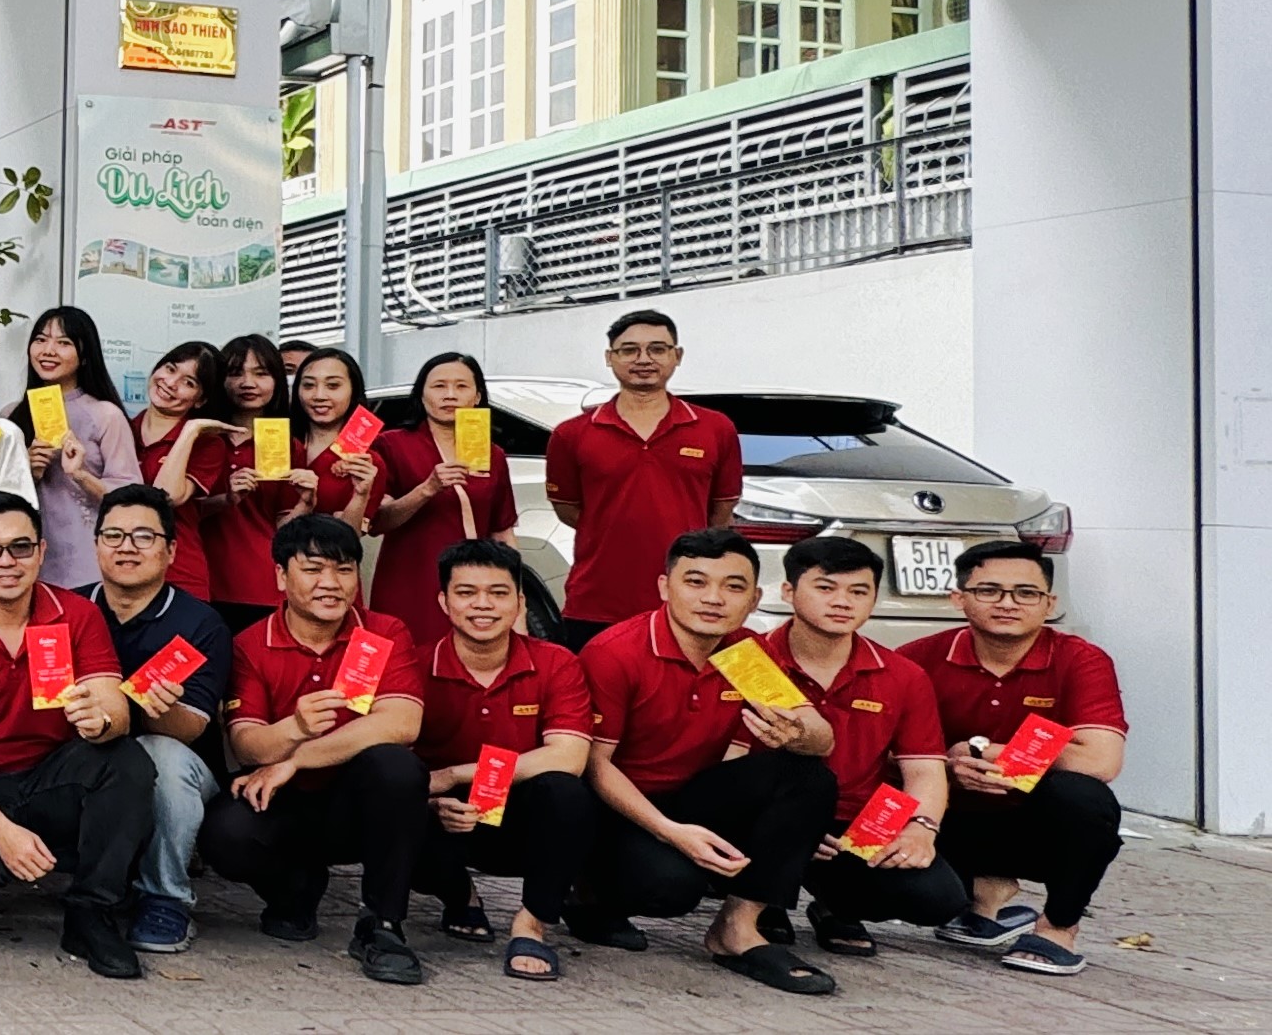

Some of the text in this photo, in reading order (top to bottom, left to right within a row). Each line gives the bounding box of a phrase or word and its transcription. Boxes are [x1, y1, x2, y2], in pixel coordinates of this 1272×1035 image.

[162, 118, 203, 131] AST
[105, 146, 183, 165] Giải pháp
[97, 163, 155, 207] Du
[197, 214, 264, 232] toàn diện
[911, 540, 951, 566] 51H
[900, 566, 957, 592] 105.2
